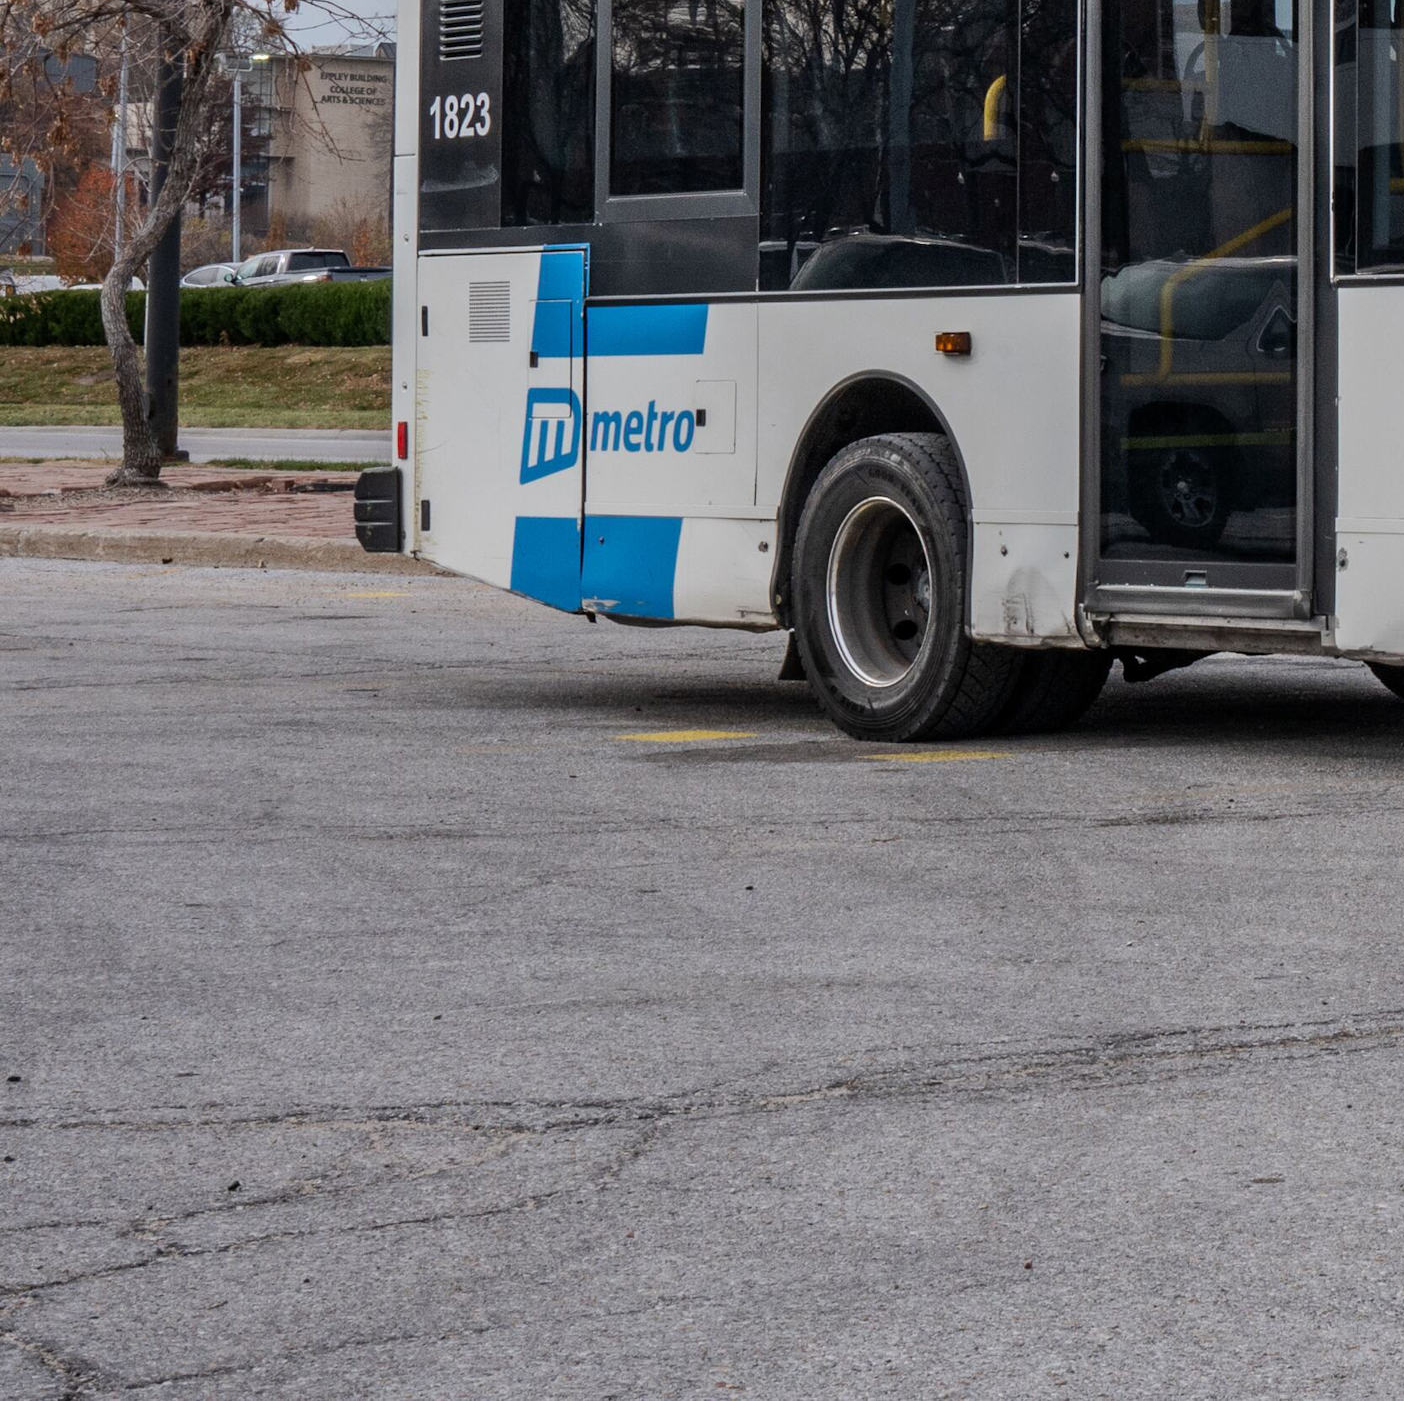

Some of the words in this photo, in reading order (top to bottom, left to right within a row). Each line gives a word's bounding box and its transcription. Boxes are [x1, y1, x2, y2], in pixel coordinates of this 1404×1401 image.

[349, 73, 388, 83] BUILDING
[330, 85, 365, 95] COLLEGE
[366, 87, 378, 96] OF
[321, 95, 341, 104] ARTS
[349, 97, 386, 106] SCIENCES
[429, 92, 491, 140] 1823
[589, 399, 695, 453] metro
